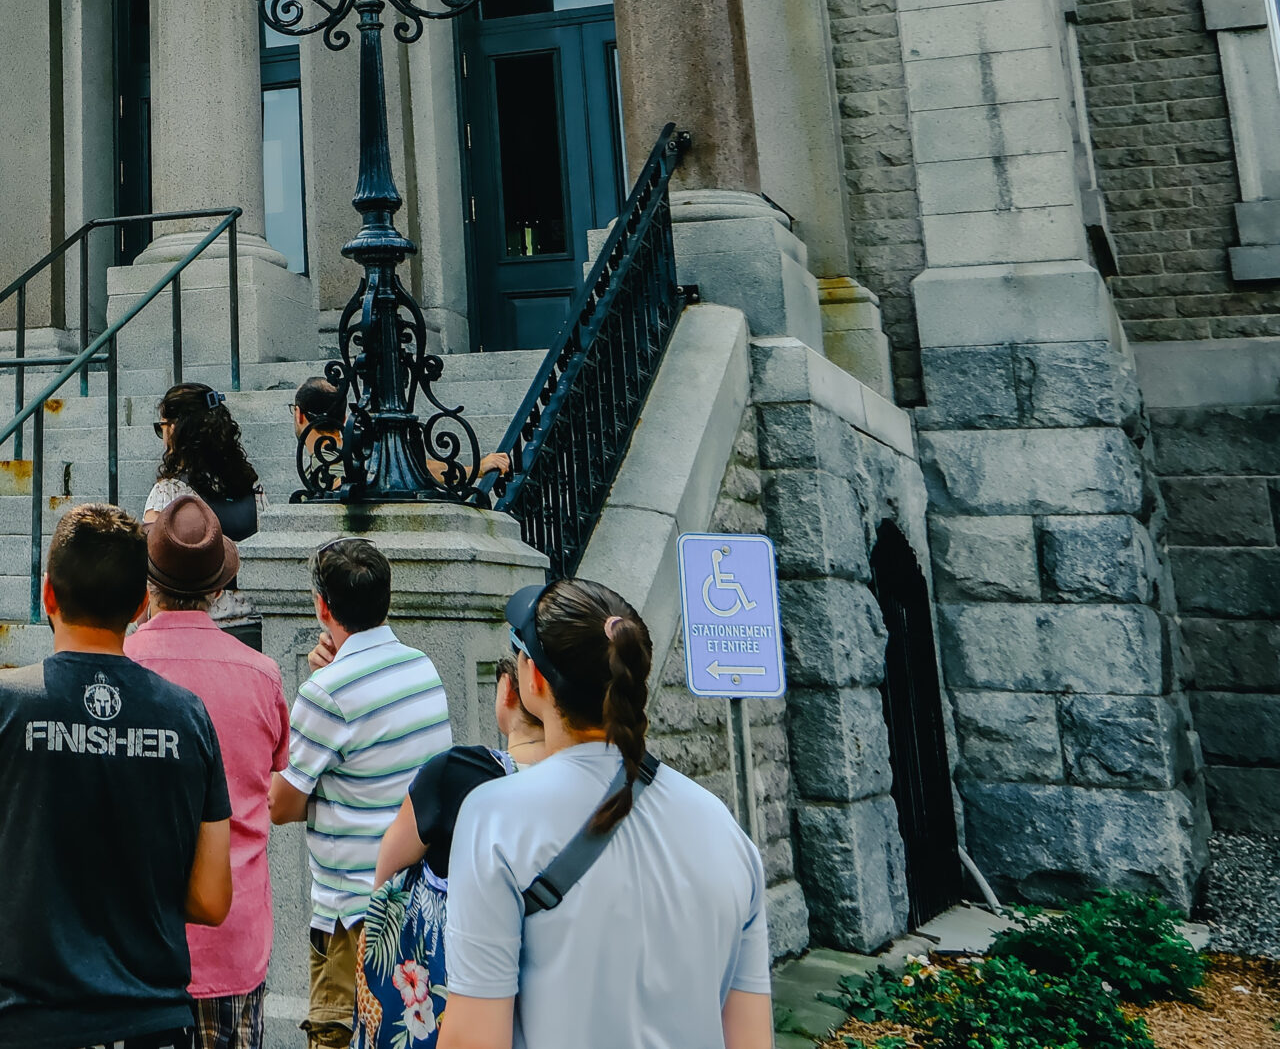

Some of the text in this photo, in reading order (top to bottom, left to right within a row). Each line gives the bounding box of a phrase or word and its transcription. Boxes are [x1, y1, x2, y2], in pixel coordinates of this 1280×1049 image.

[691, 624, 773, 637] STATIONNEMENT
[707, 637, 760, 653] ET ENTRÉE
[25, 721, 180, 759] FINISHER
